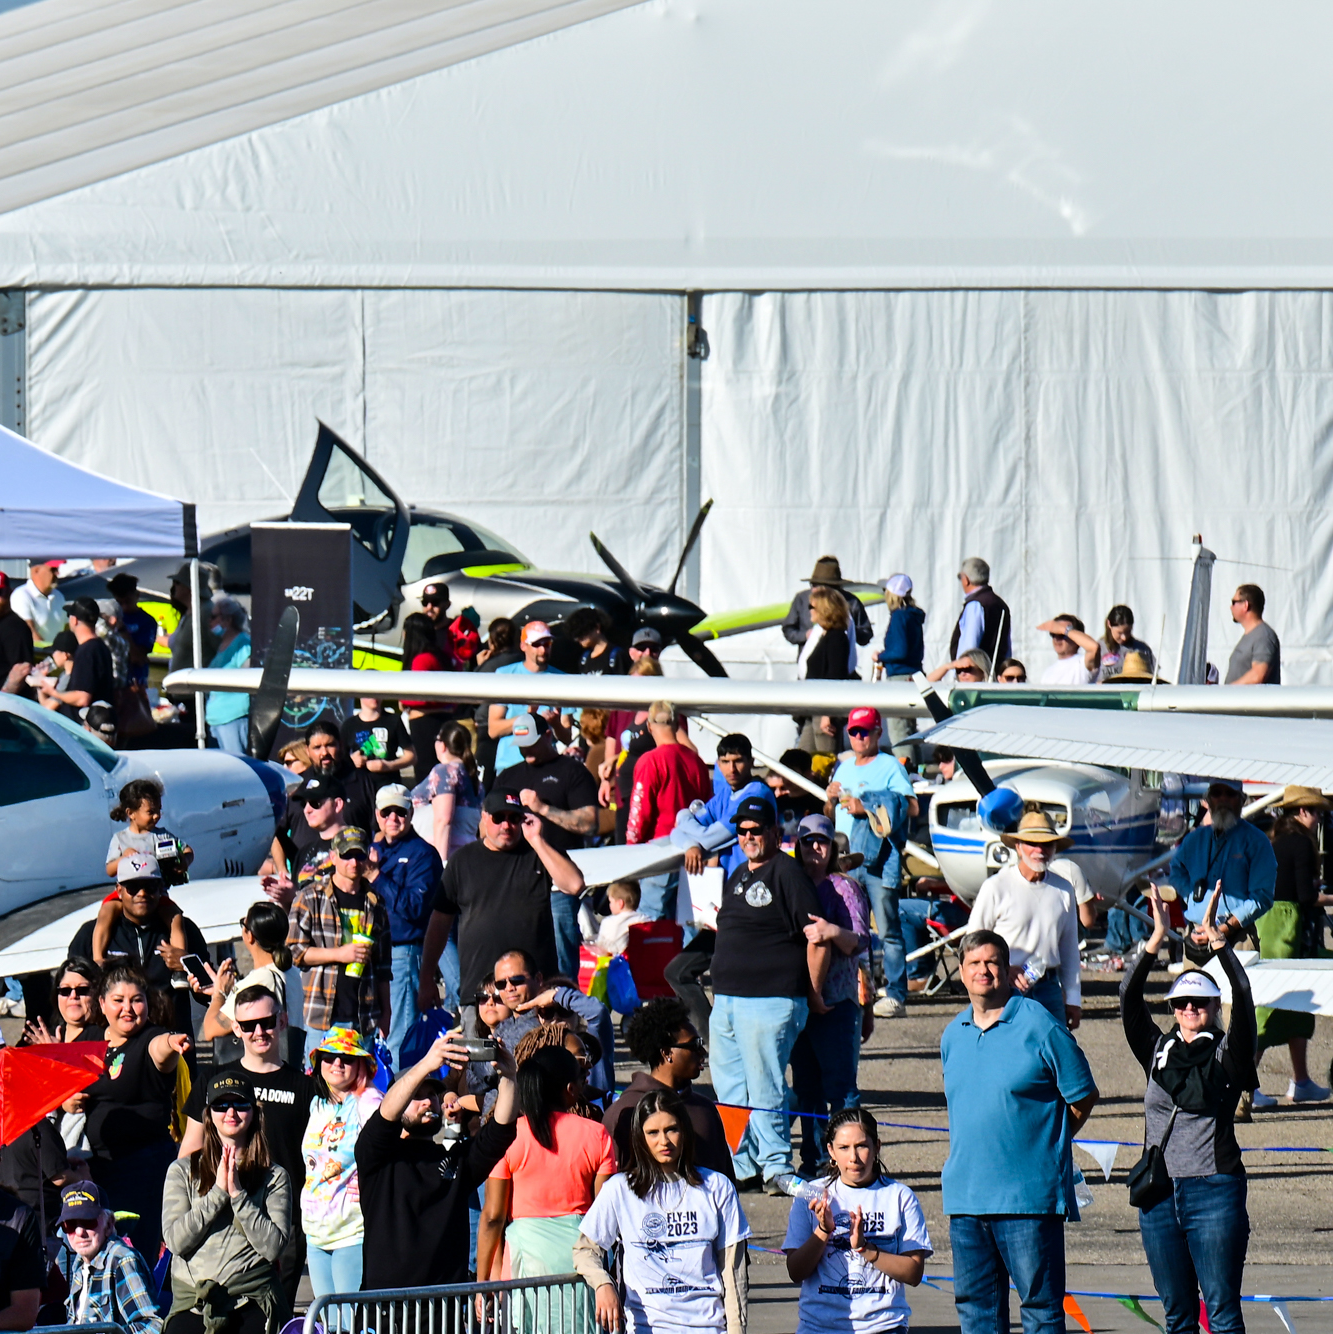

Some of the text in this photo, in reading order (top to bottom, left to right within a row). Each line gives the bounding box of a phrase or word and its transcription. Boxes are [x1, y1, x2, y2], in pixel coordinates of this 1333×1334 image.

[667, 1211, 697, 1223] FLY-IN
[861, 1211, 885, 1221] LY-IN
[667, 1222, 698, 1237] 2023
[862, 1221, 885, 1234] 023
